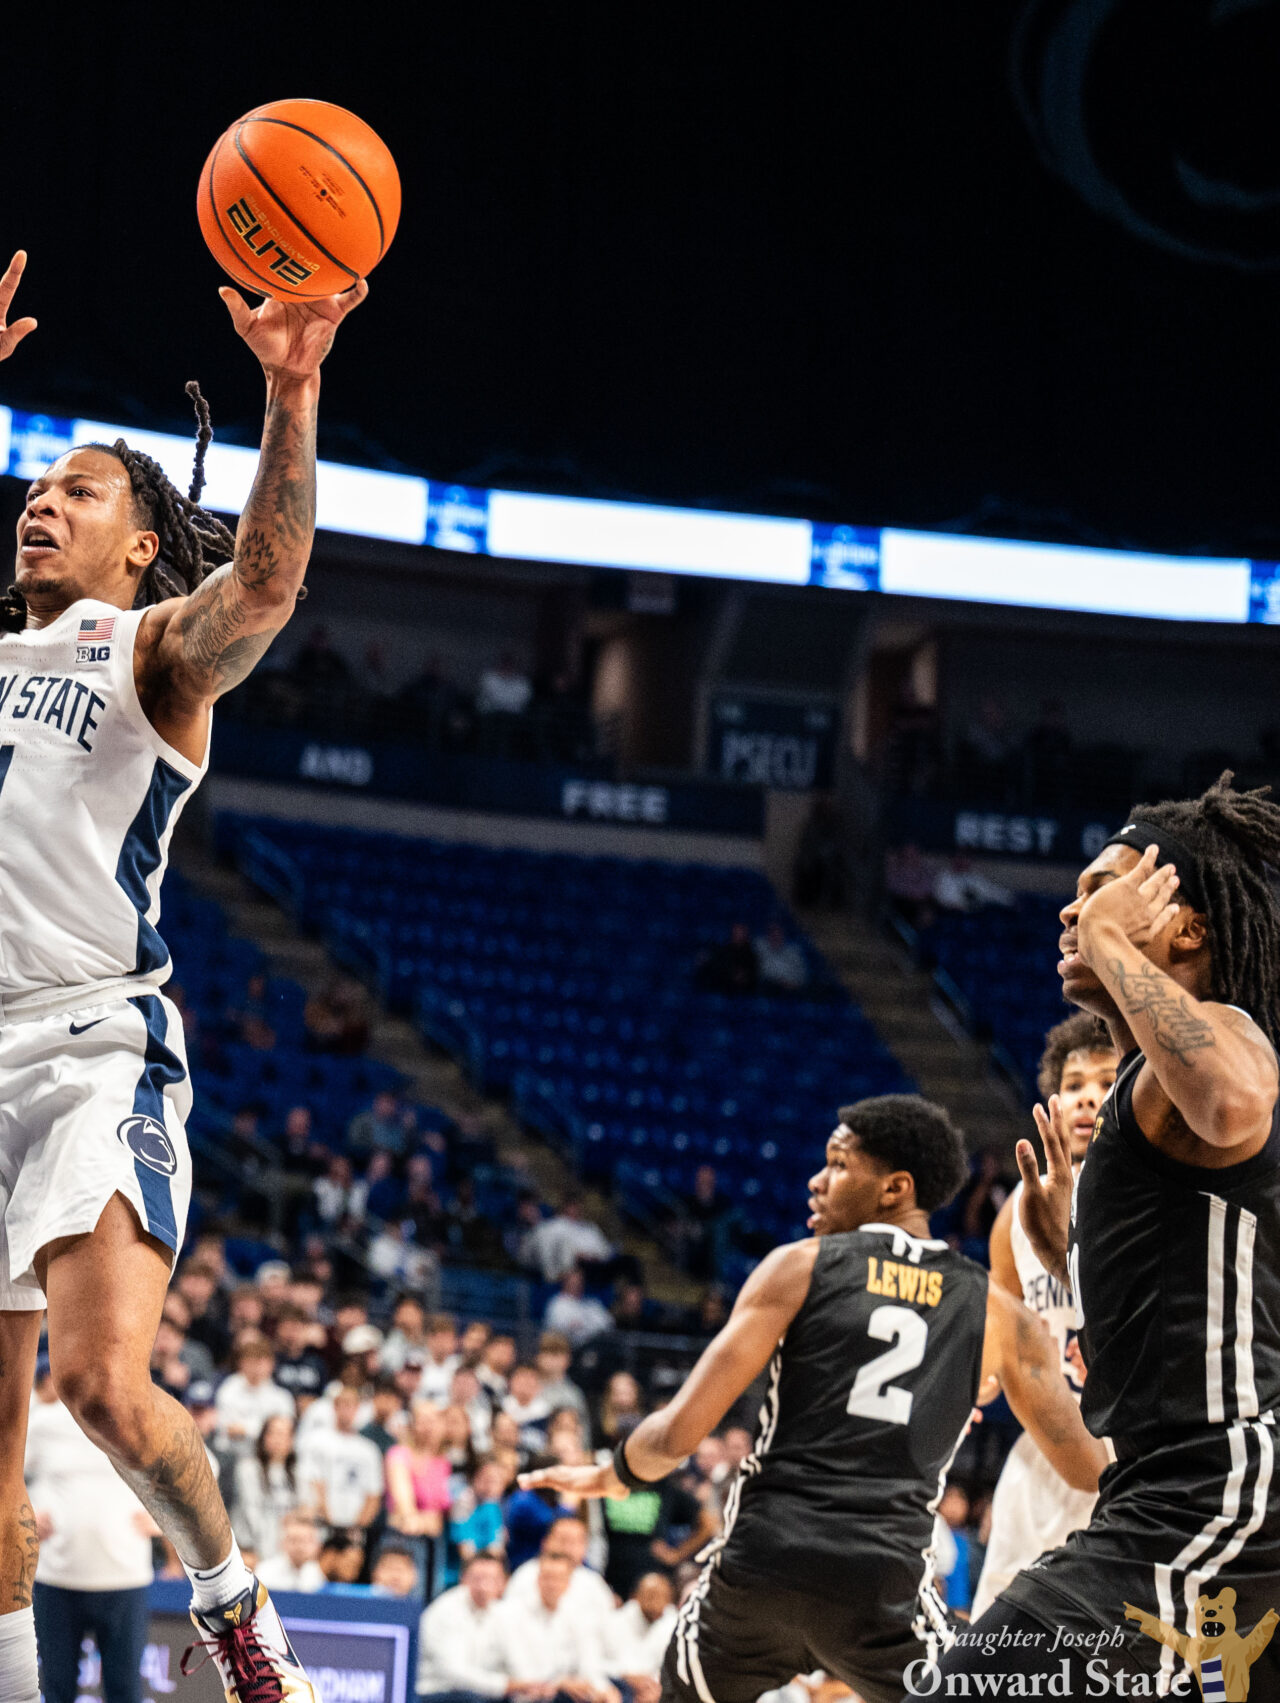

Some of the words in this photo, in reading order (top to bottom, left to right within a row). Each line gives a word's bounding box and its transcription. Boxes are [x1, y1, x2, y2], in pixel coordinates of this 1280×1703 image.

[226, 197, 313, 287] ELITE
[12, 676, 107, 753] STATE
[562, 779, 668, 824] FREE
[956, 813, 1058, 855] REST
[866, 1256, 943, 1307] LEWIS
[846, 1305, 929, 1426] 2
